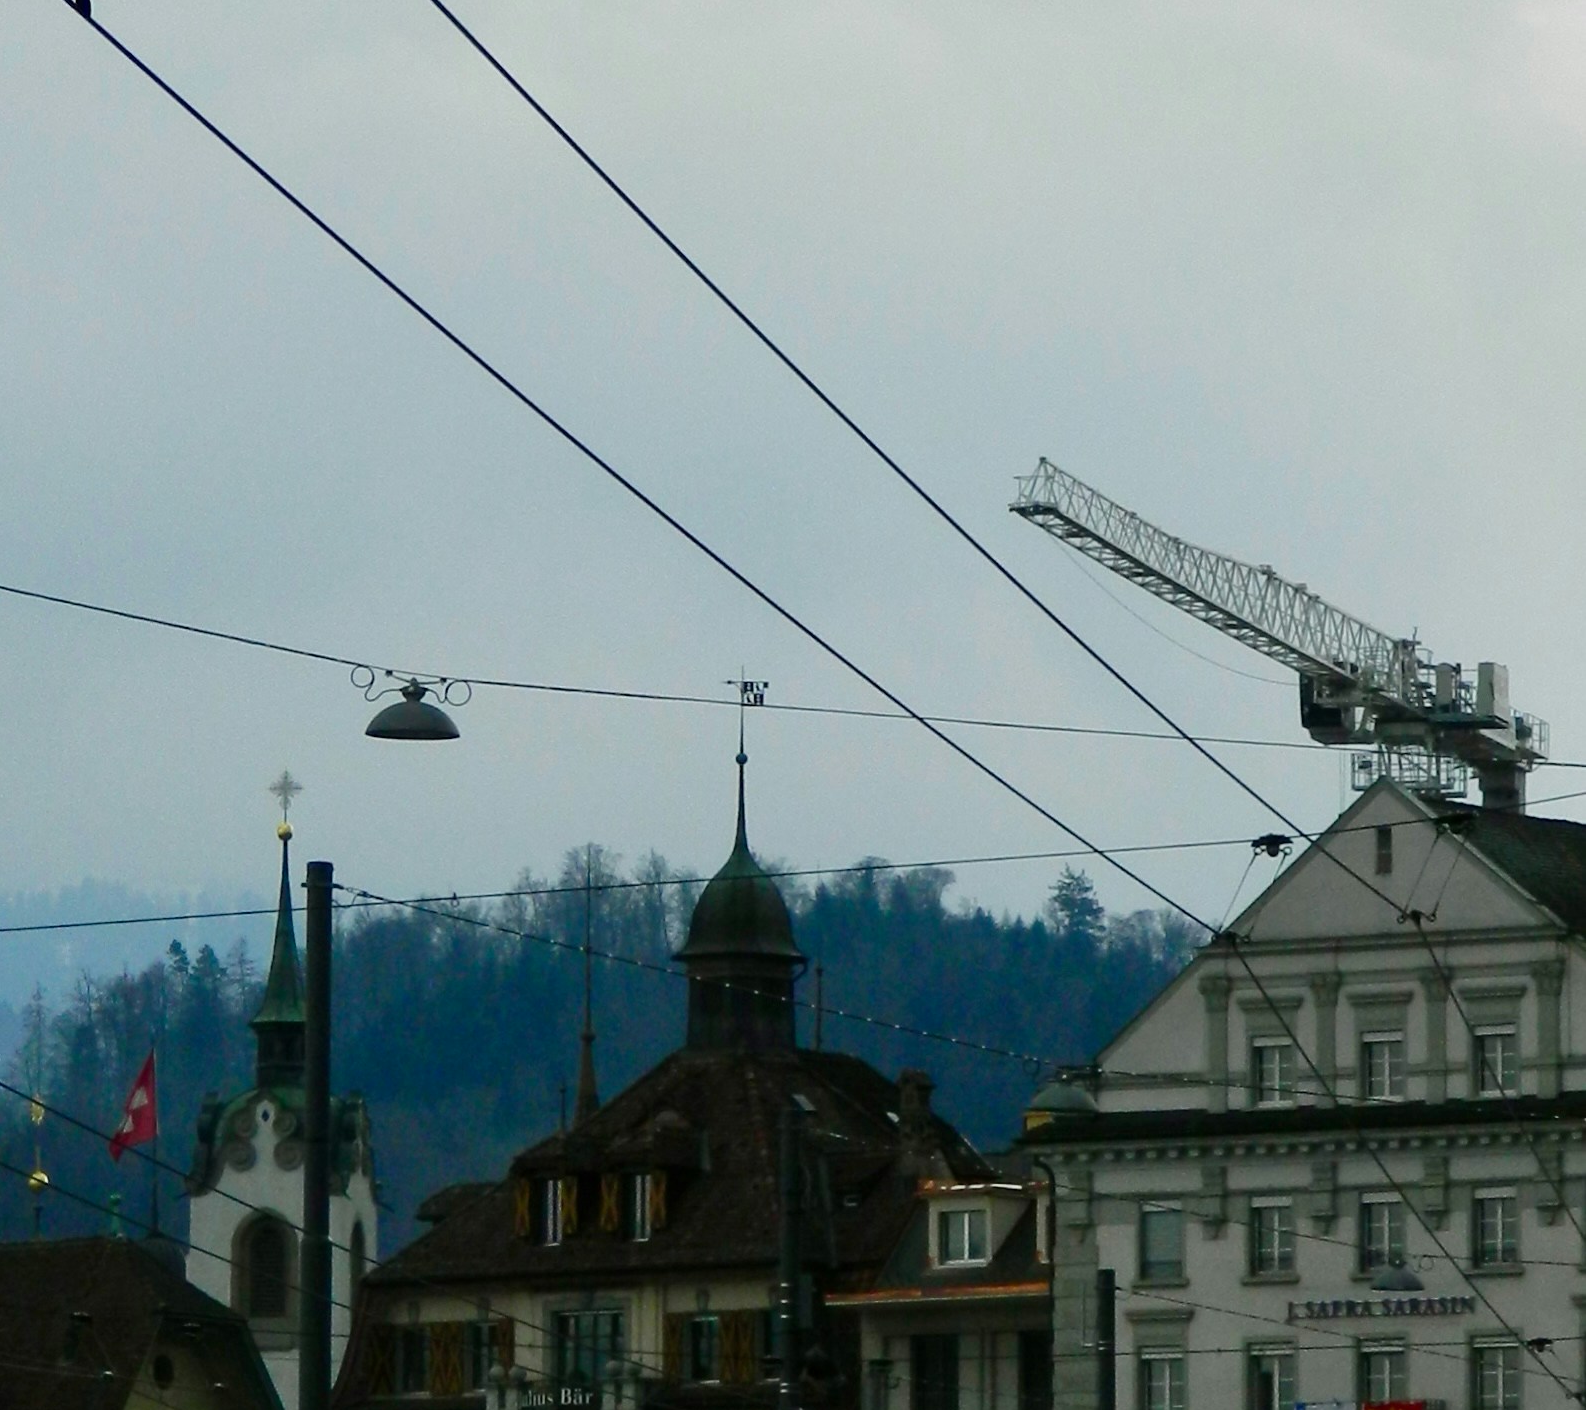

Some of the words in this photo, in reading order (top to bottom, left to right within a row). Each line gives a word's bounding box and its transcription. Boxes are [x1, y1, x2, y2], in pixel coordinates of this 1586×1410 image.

[1305, 1299, 1373, 1319] SAFRA
[1381, 1295, 1476, 1317] SARASIN
[560, 1386, 594, 1406] Bär
